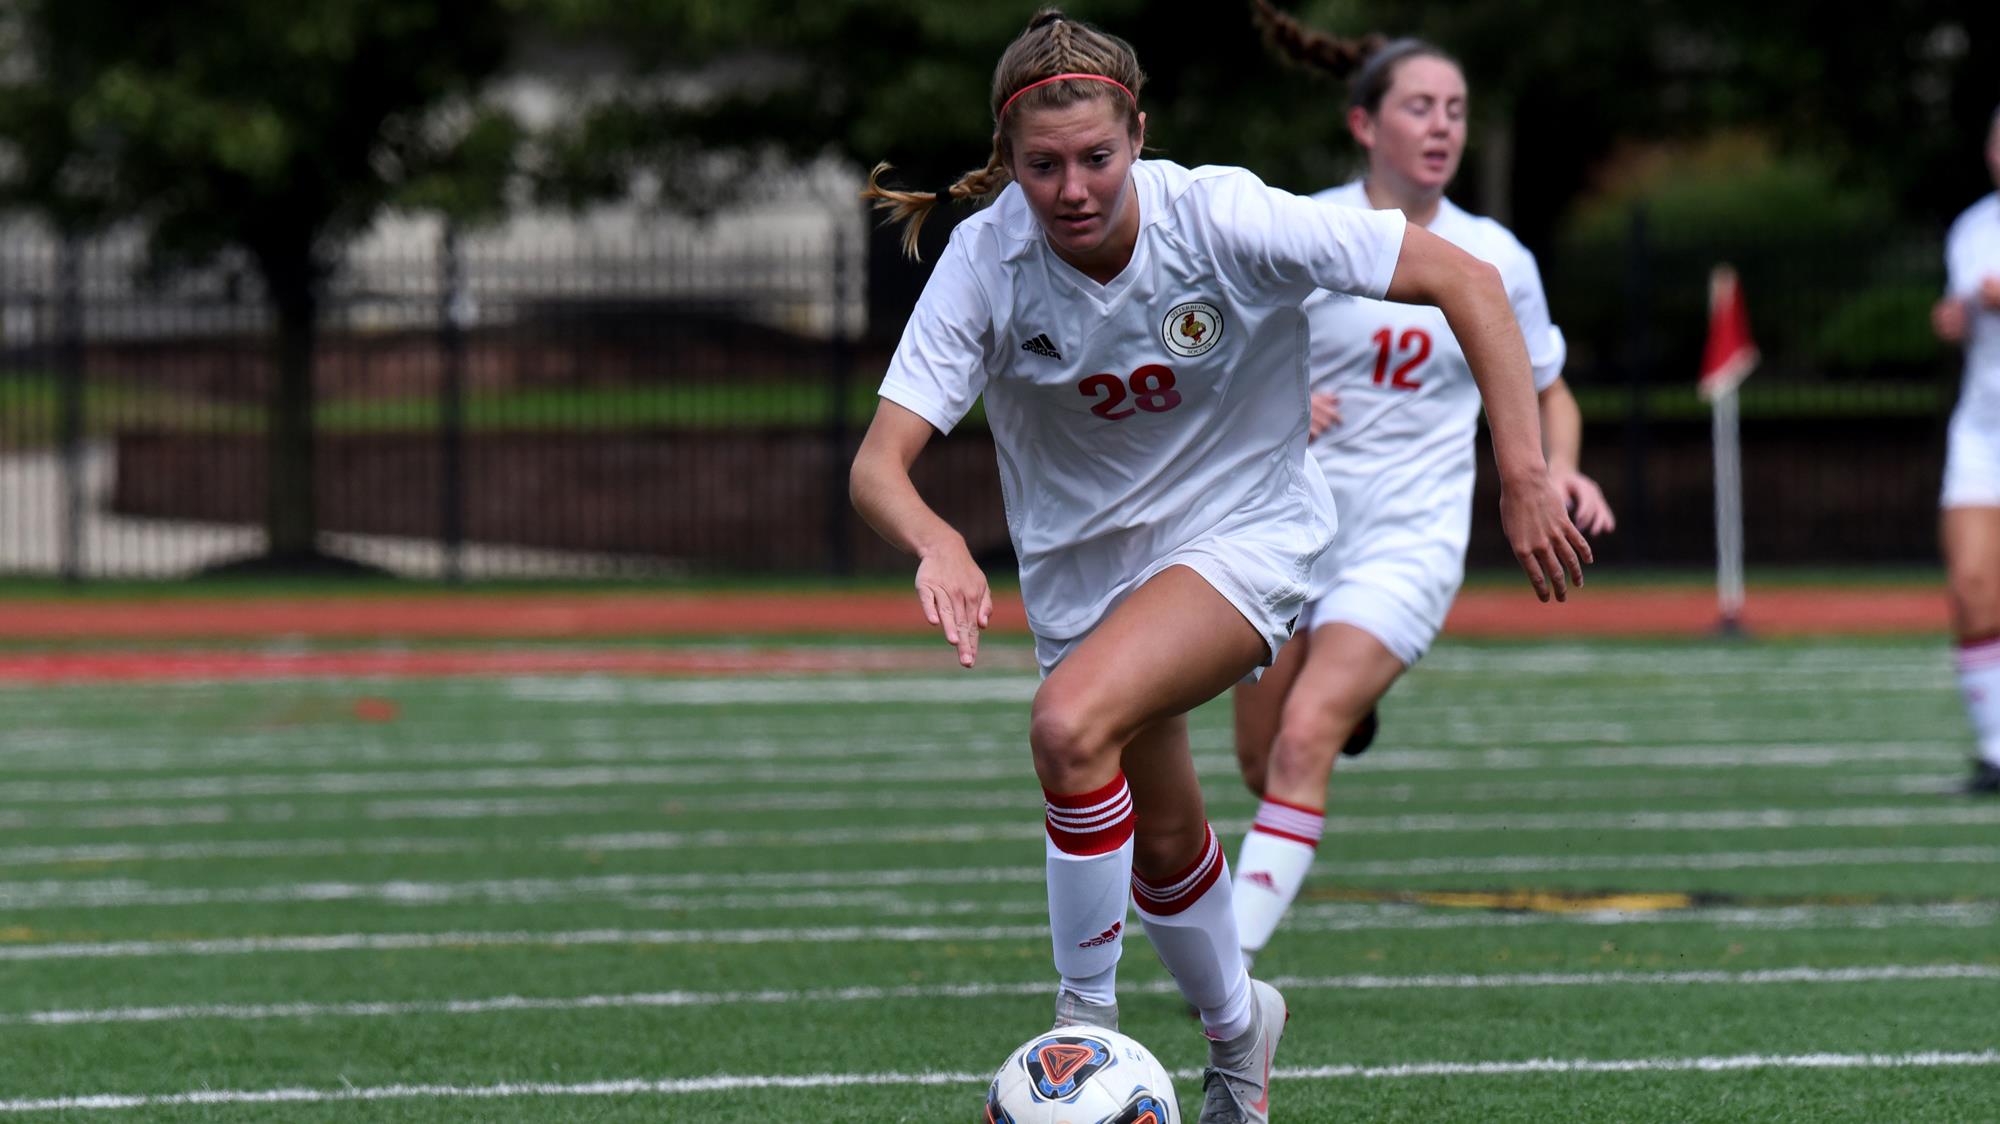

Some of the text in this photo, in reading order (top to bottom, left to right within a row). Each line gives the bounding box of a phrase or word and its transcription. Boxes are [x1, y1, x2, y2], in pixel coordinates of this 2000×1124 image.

[1021, 342, 1062, 361] adidas
[1371, 327, 1434, 393] 12
[1078, 364, 1183, 421] 28
